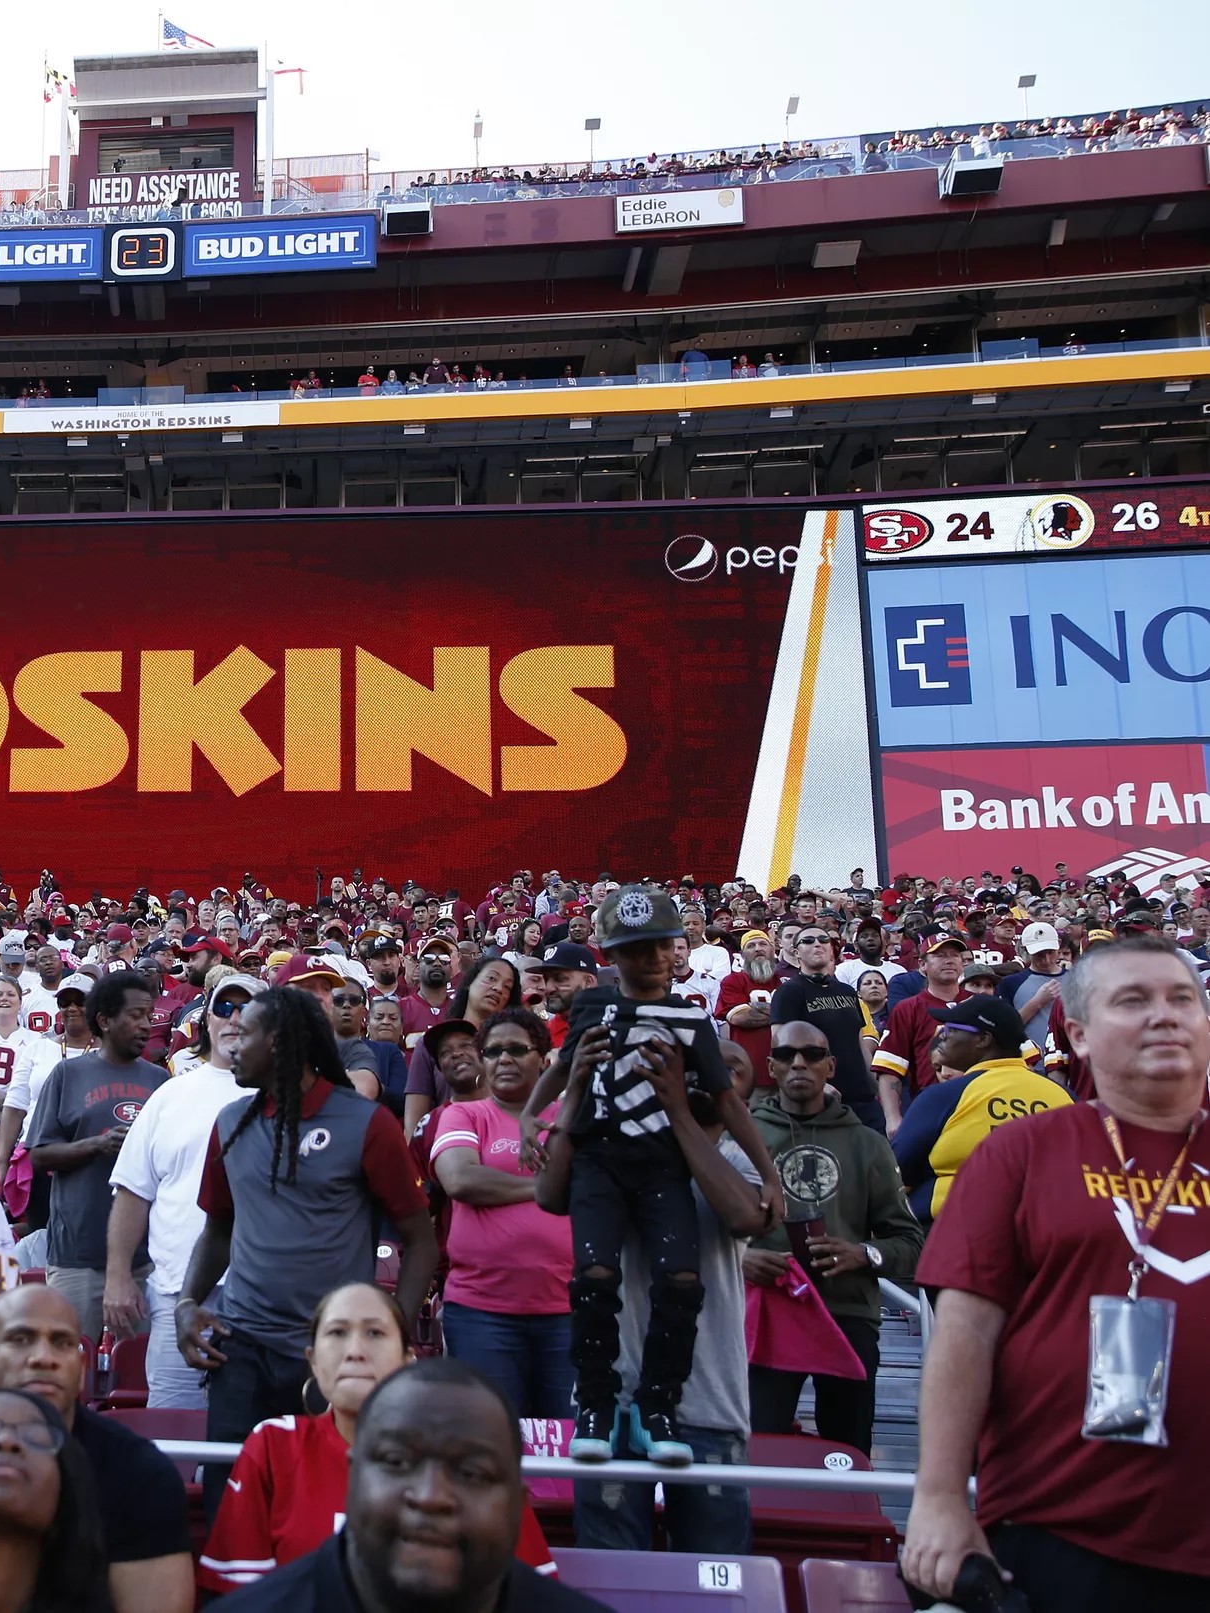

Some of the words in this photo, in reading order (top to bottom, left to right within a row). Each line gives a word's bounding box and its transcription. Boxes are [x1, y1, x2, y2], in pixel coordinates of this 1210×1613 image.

[89, 177, 132, 204] NEED
[622, 198, 667, 211] Eddie
[622, 210, 700, 226] LEBARON
[123, 237, 164, 265] 23
[198, 236, 264, 260] BUD
[51, 418, 151, 430] WASHINGTON
[157, 415, 232, 427] REDSKINS
[946, 511, 995, 542] 24
[1111, 501, 1160, 532] 26
[940, 786, 1077, 831] Bank
[1082, 783, 1136, 827] of
[829, 1457, 848, 1467] 20
[709, 1564, 729, 1587] 19
